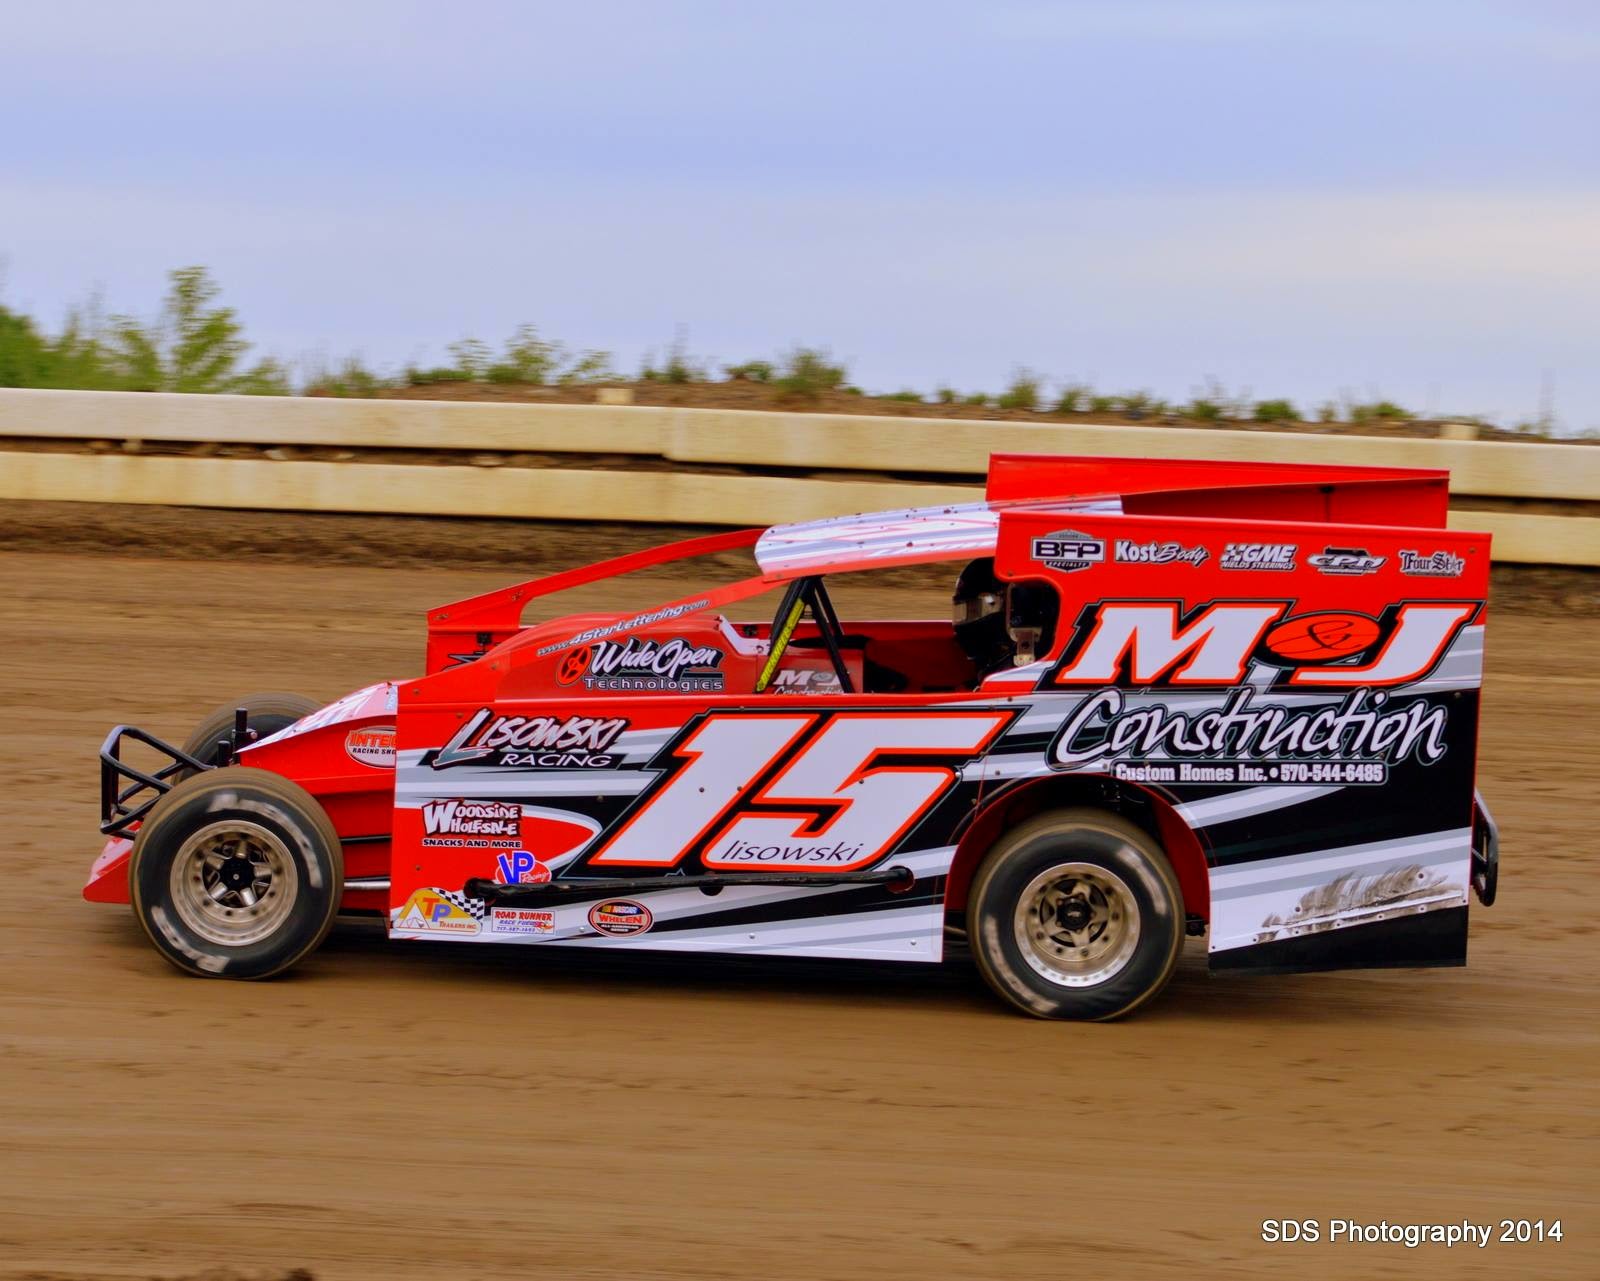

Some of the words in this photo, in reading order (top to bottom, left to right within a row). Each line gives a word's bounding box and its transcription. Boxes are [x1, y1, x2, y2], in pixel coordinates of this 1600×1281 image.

[1036, 541, 1101, 558] BFP
[1115, 540, 1158, 562] Kost
[1156, 544, 1209, 567] Body
[584, 677, 724, 692] Technologies
[1054, 689, 1445, 764] Construction
[432, 707, 629, 770] LISOWSKI
[352, 747, 379, 755] RACING
[500, 753, 613, 767] RACING
[1115, 763, 1175, 783] Custom
[1180, 763, 1237, 783] Homes
[1240, 763, 1269, 784] Inc.
[1280, 763, 1384, 783] 570-544-6485
[587, 712, 1016, 871] 15
[423, 838, 463, 847] SNACKS
[466, 839, 489, 848] AND
[490, 840, 522, 849] MORE
[720, 839, 865, 863] lisowski
[497, 850, 536, 884] VP
[422, 897, 451, 923] TP
[495, 910, 517, 919] ROAD
[518, 911, 553, 921] RUNNER
[599, 913, 643, 925] WHELEN
